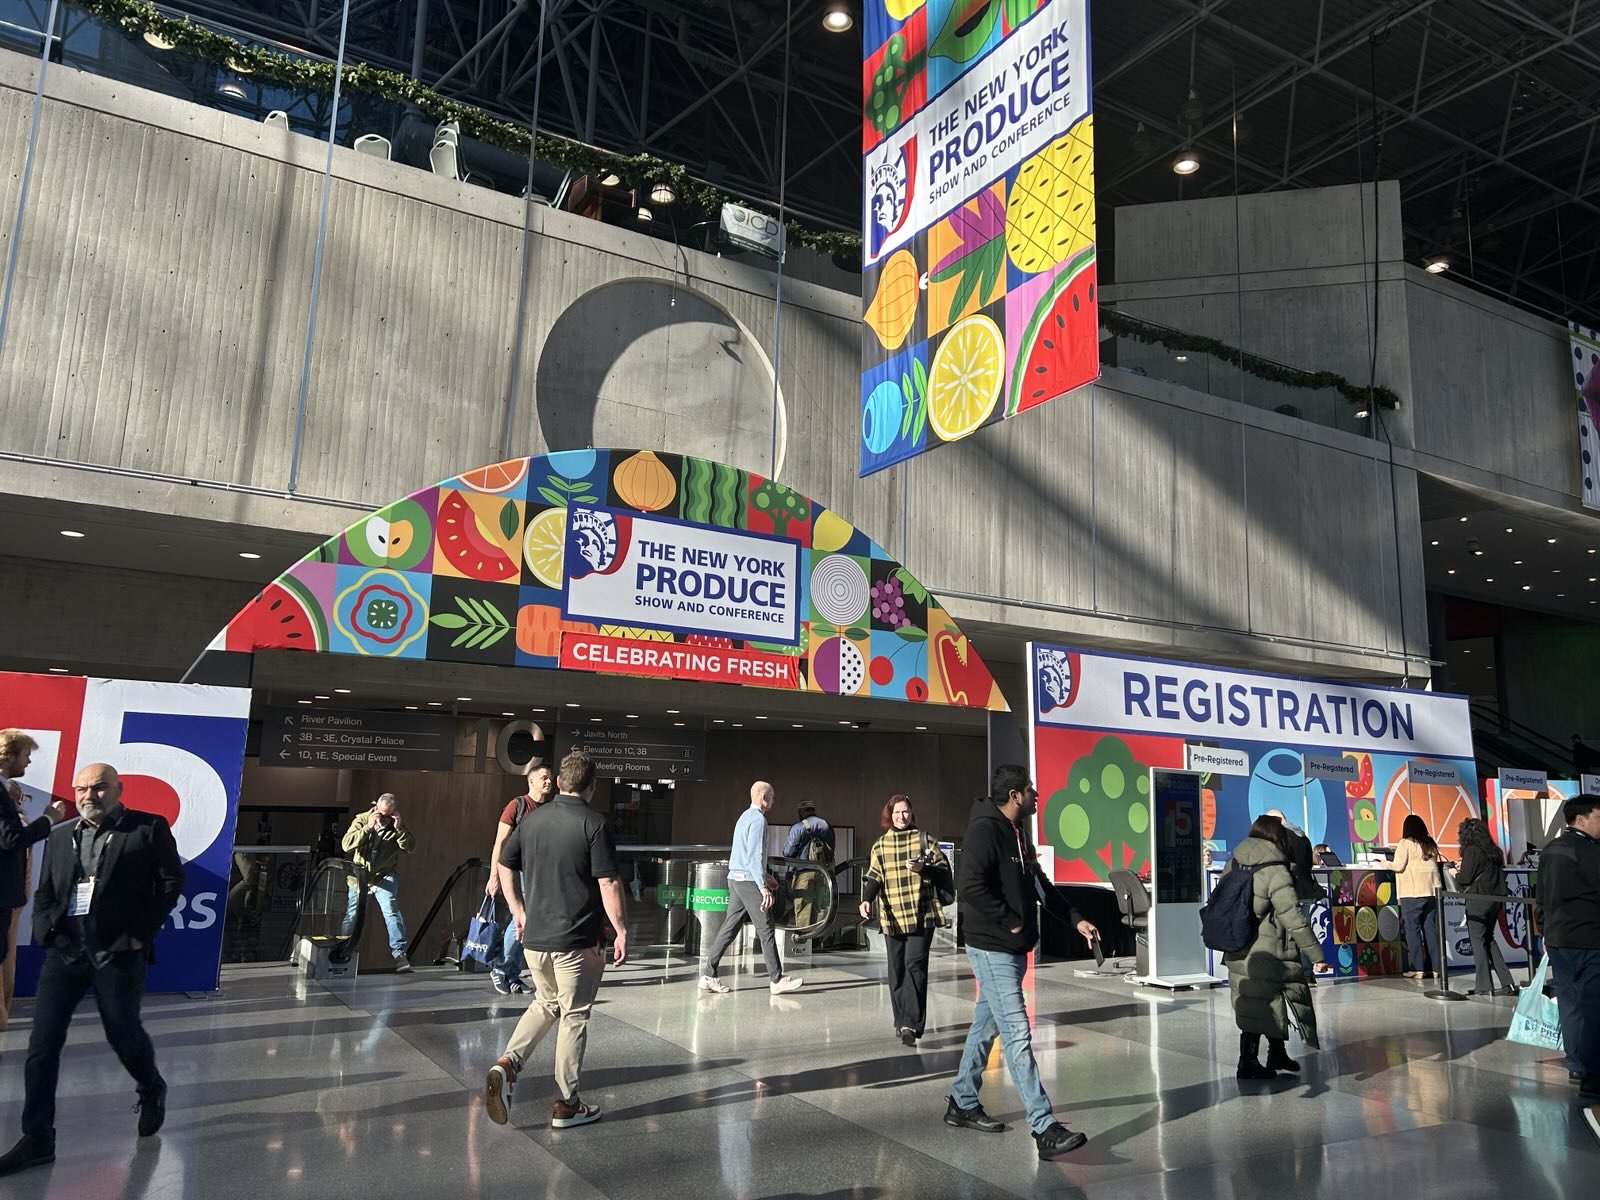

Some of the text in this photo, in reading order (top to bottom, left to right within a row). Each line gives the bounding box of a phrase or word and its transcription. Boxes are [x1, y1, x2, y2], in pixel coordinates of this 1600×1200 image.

[929, 20, 1069, 146] THE NEW YORK
[929, 50, 1071, 186] PRODUCE
[929, 92, 1071, 204] SHOW AND CONFERENCE
[637, 539, 785, 578] THE NEW YORK
[635, 562, 786, 609] PRODUCE
[635, 595, 785, 624] SHOW AND CONFERENCE
[572, 642, 789, 680] CELEBRATING FRESH
[1123, 671, 1415, 741] REGISTRATION
[301, 715, 363, 726] River Pavilion
[299, 733, 313, 741] 3B
[323, 734, 338, 744] 3E,
[340, 735, 372, 746] Crystal
[375, 736, 405, 745] Palace
[584, 730, 628, 739] Javits North
[464, 719, 545, 776] 1C
[583, 745, 613, 754] Elevator
[298, 751, 398, 763] 1D, 1E, Special Events
[1193, 753, 1244, 767] Pre-Registered
[625, 763, 651, 771] Rooms
[1310, 761, 1354, 774] Pre-Registered
[1413, 767, 1455, 779] Pre-Registered
[1505, 774, 1543, 785] Pre-Registered
